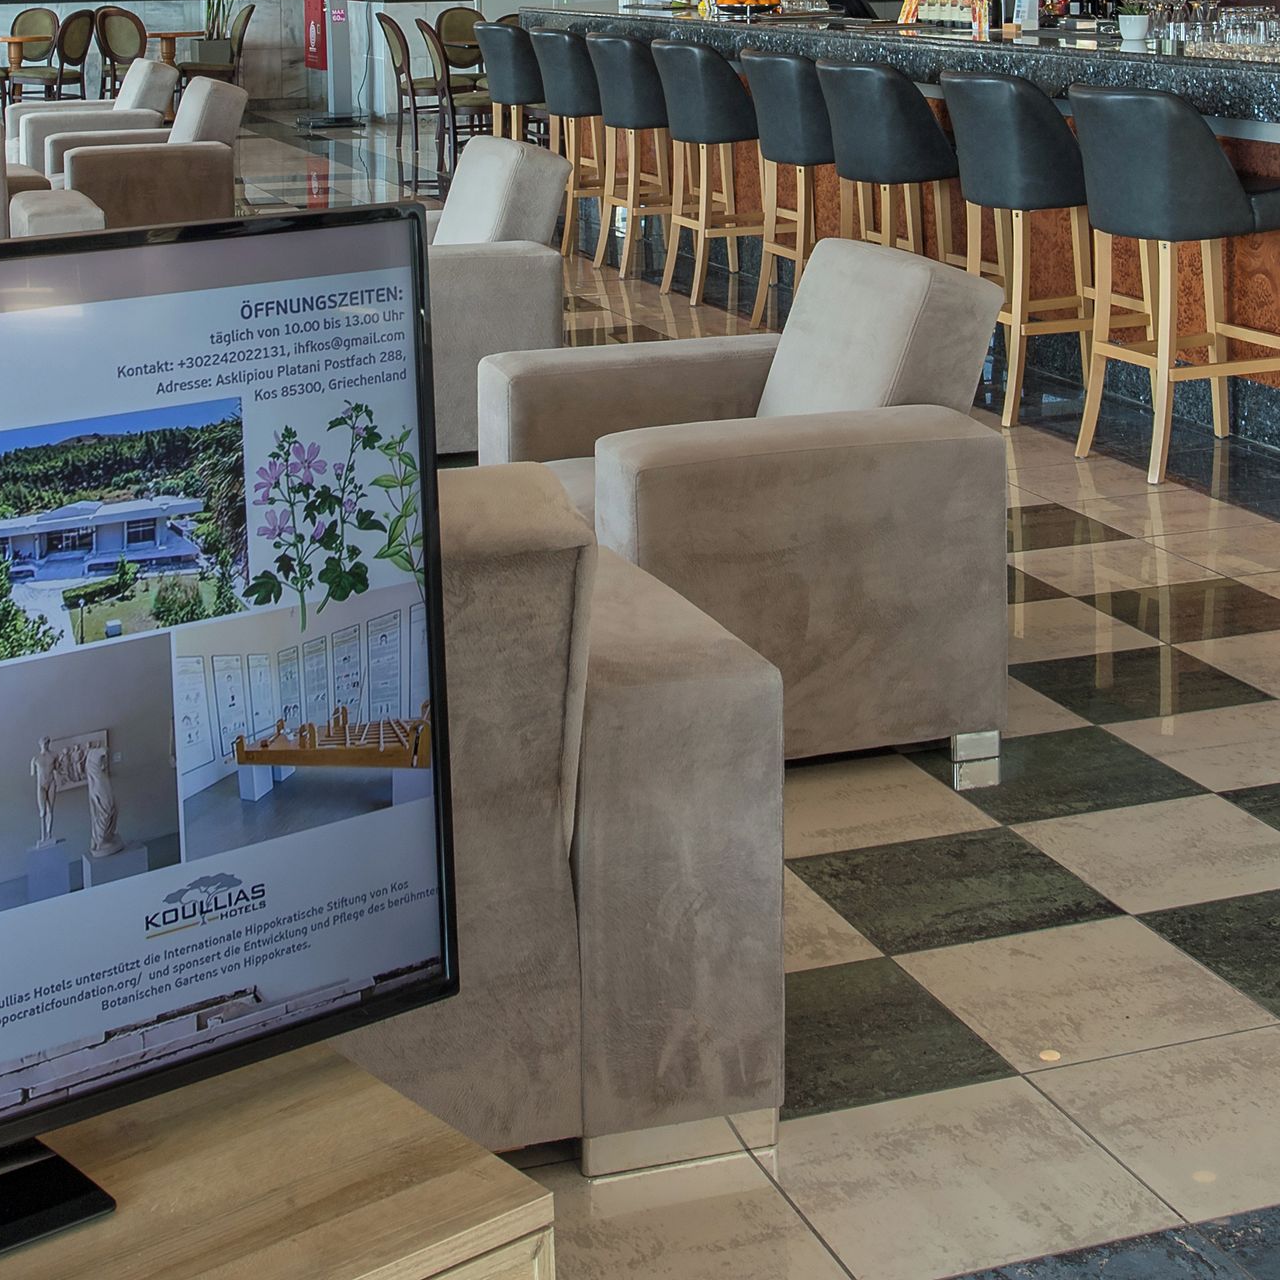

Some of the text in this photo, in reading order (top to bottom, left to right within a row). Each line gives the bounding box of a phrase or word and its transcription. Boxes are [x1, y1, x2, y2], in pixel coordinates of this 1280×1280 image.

[241, 286, 403, 320] ÖFFNUNGSZEITEN:
[210, 310, 404, 346] täglich von 10.00 bis 13.00 Uhr
[118, 332, 404, 378] Kontakt: +302242022131, ihfkos@gmail.com
[156, 349, 406, 395] Adresse: Asklipiou Platani Postfach 288,
[255, 368, 407, 401] Kos 85300, Griechenland
[144, 883, 266, 930] KOULLIAS
[220, 900, 266, 920] HOTELS
[34, 979, 72, 999] Hotels
[76, 959, 140, 986] unterstützt
[144, 953, 160, 966] die
[164, 930, 242, 960] Internationale
[245, 906, 324, 936] Hippokratische
[327, 894, 366, 912] Stiftung
[370, 888, 388, 899] von
[390, 881, 408, 892] Kos
[149, 965, 170, 980] und
[172, 951, 221, 974] sponsert
[224, 945, 240, 958] die
[244, 926, 308, 952] Entwicklung
[311, 917, 330, 931] und
[333, 909, 364, 925] Pflege
[368, 903, 385, 914] des
[102, 941, 311, 1011] Botanischen Gartens von Hippokrates.
